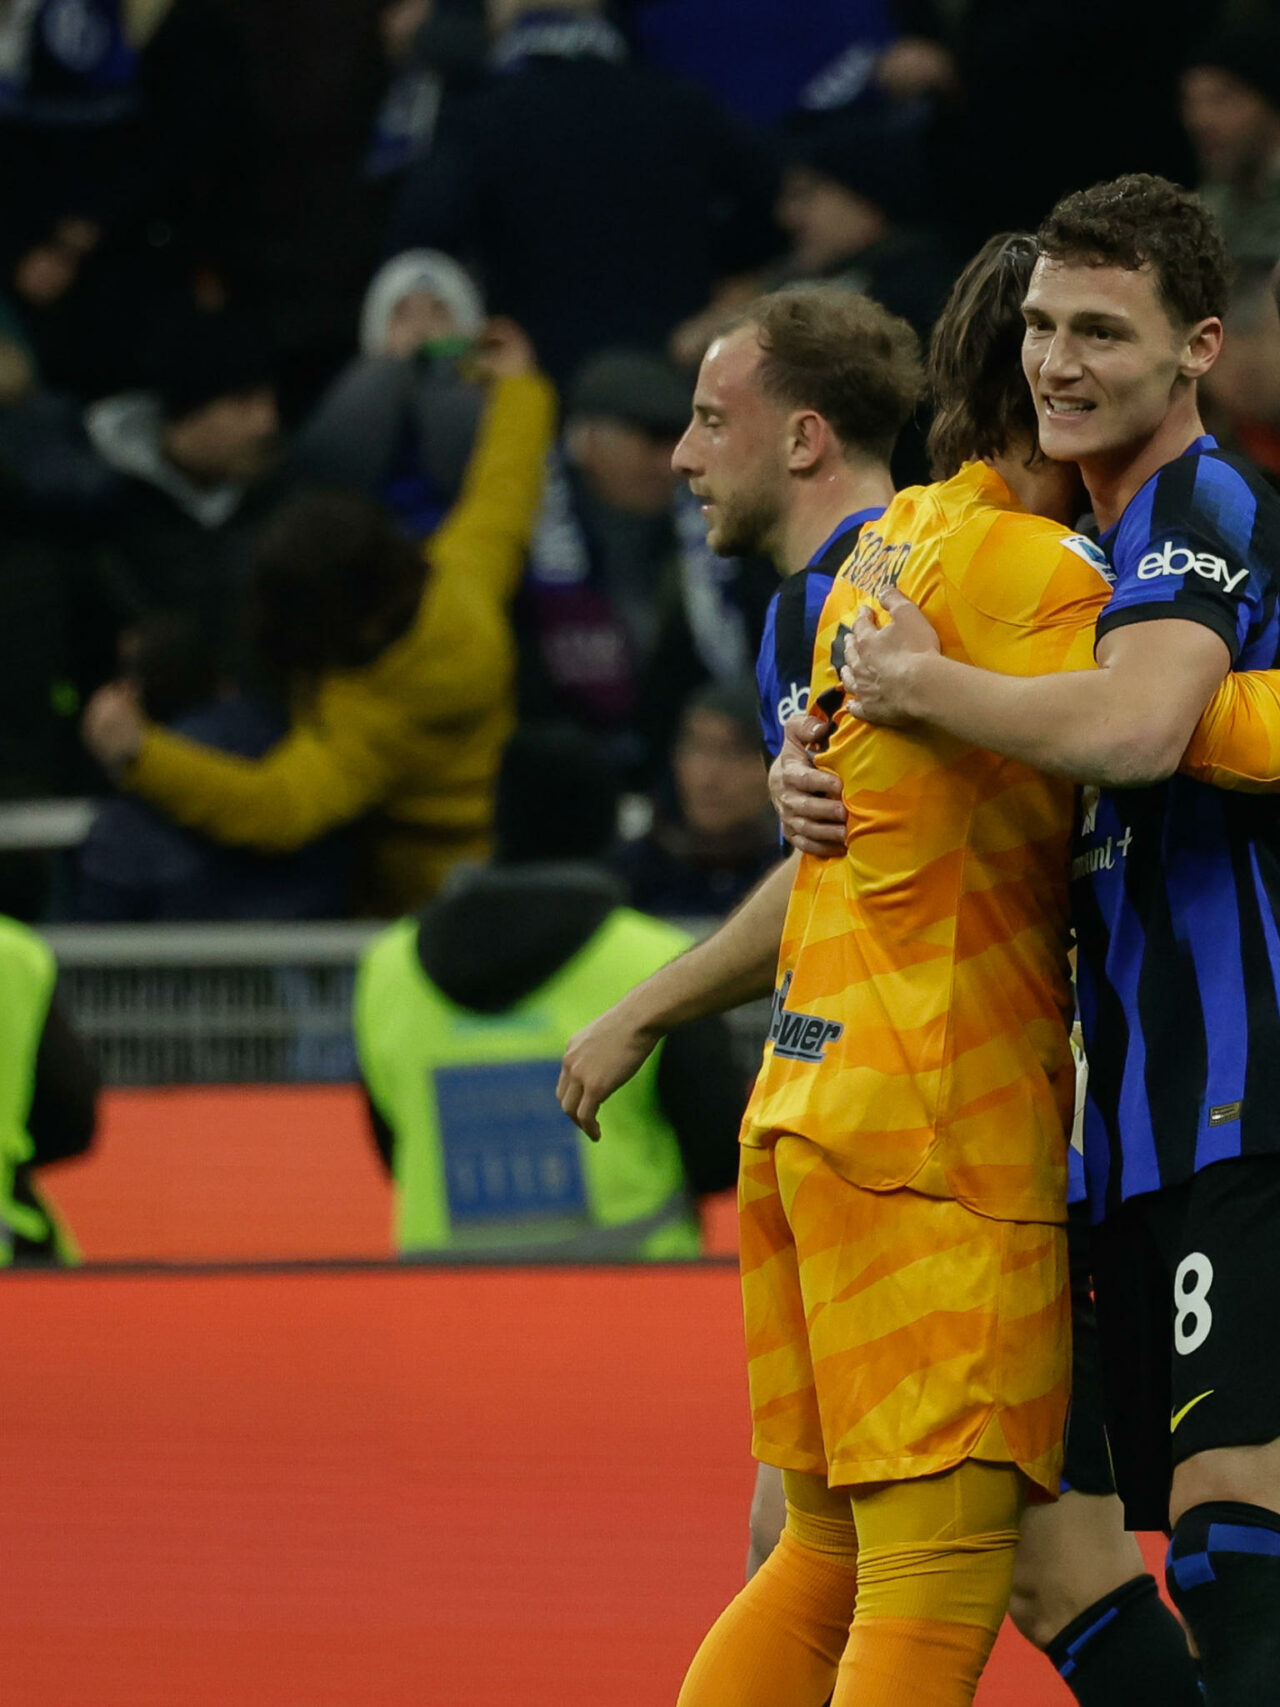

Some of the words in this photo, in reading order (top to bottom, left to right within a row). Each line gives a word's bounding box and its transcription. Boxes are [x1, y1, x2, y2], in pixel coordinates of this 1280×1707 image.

[1137, 541, 1250, 593] ebay
[777, 682, 811, 726] eb
[1174, 1252, 1213, 1355] 8
